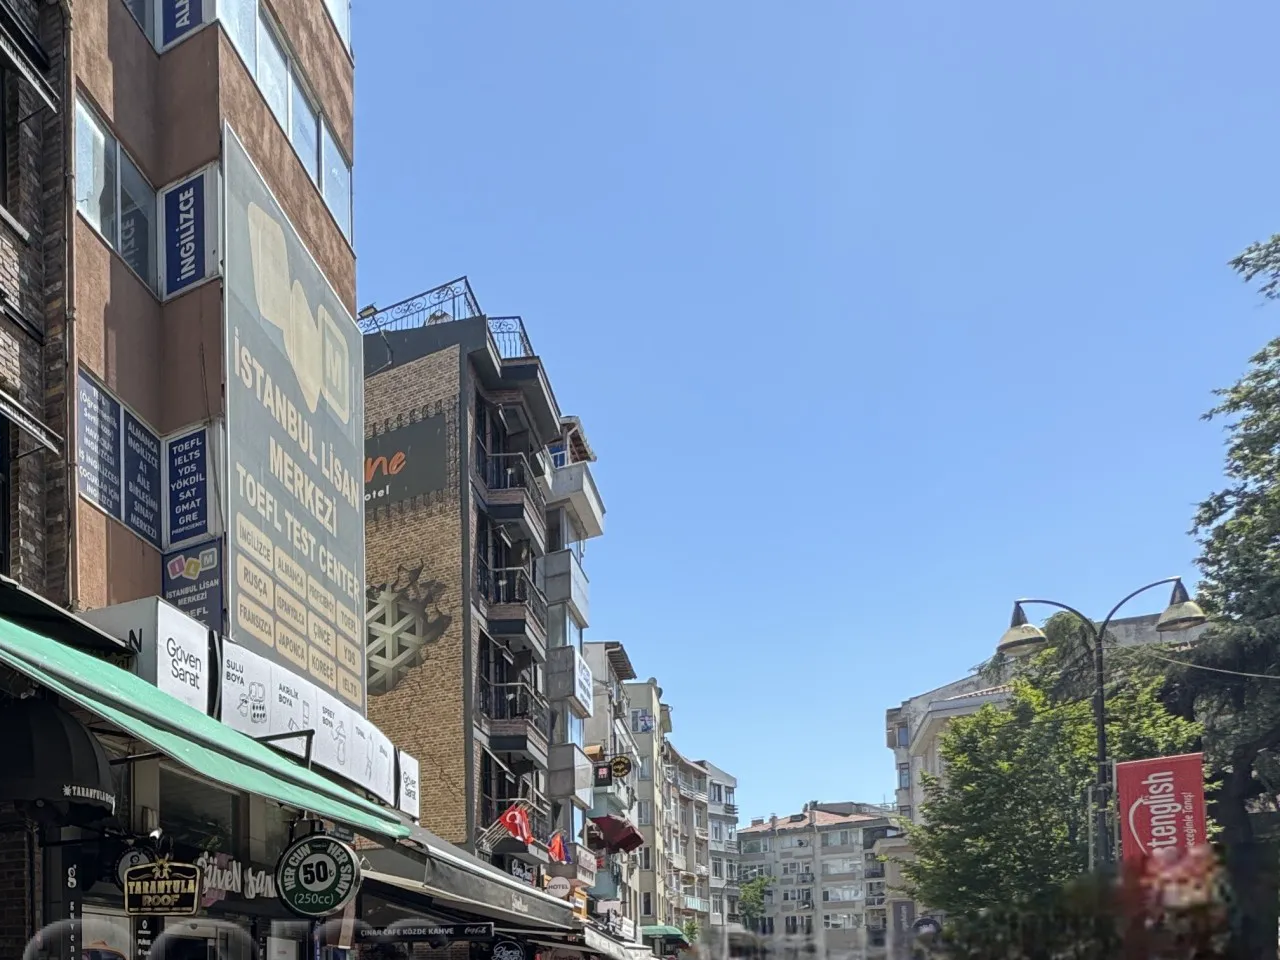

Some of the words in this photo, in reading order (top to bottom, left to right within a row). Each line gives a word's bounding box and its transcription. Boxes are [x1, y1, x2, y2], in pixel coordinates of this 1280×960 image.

[176, 187, 195, 282] İNGİLİZCE
[234, 326, 318, 466] İSTANBUL
[321, 441, 360, 513] LİSAN
[172, 437, 202, 455] TOEFL
[174, 450, 201, 467] IELTS
[178, 463, 197, 477] YDS
[170, 473, 205, 492] YÖKDİL
[269, 436, 337, 538] MERKEZİ
[179, 488, 197, 501] SAT
[175, 498, 202, 515] GMAT
[178, 511, 198, 525] GRE
[236, 462, 283, 532] TOEFL
[284, 511, 317, 562] TEST
[318, 545, 361, 604] CENTER
[243, 566, 268, 598] RUSÇA
[166, 585, 198, 599] İSTANBUL
[178, 592, 208, 606] MERKEZİ
[239, 606, 272, 637] FRANSIZCA
[166, 637, 201, 673] Güven
[171, 659, 200, 690] Sanat
[226, 659, 244, 674] SULU
[226, 672, 245, 686] BOYA
[278, 694, 293, 708] BOYA
[72, 785, 106, 802] TARANTULA
[326, 842, 349, 865] HER
[128, 879, 196, 895] TARANTULA
[283, 867, 297, 892] HER
[335, 864, 352, 899] SAAT
[142, 894, 180, 907] ROOF
[294, 892, 334, 906] (250cc)
[428, 927, 454, 935] KAHVE
